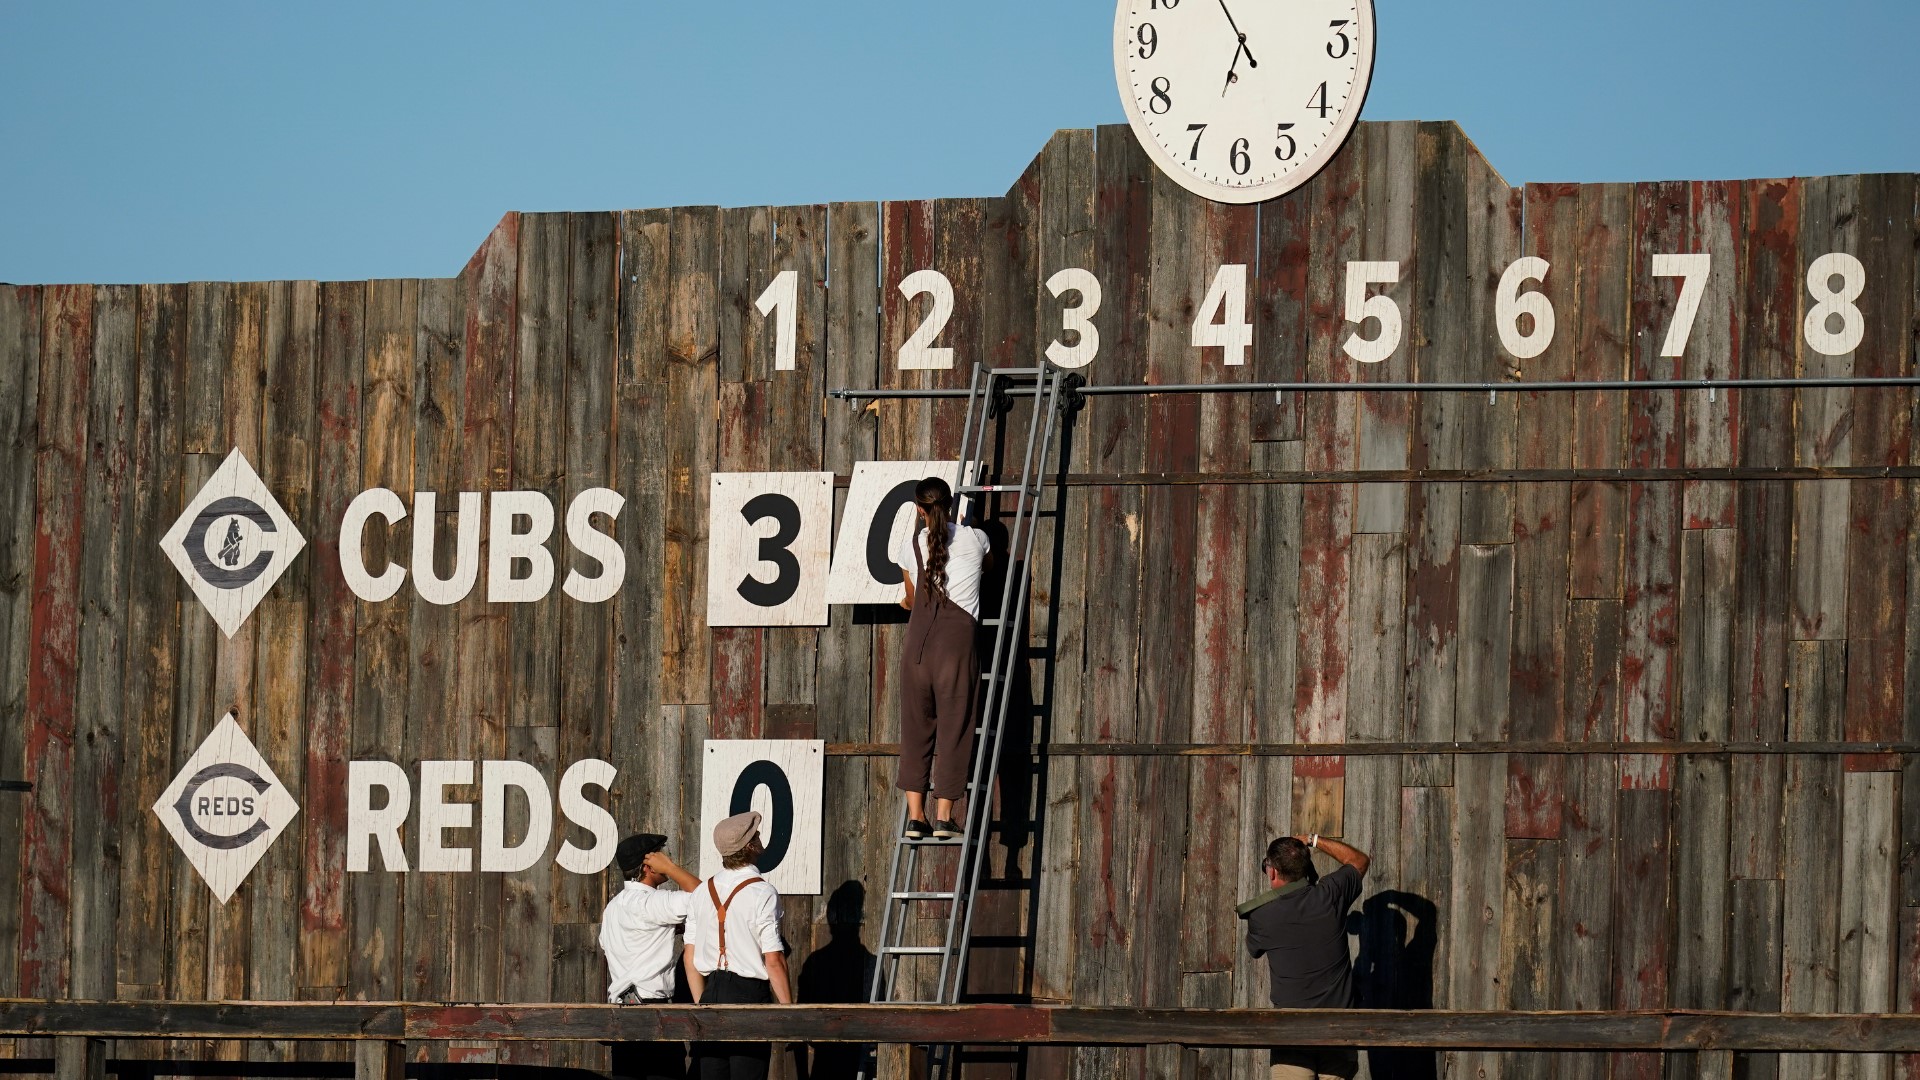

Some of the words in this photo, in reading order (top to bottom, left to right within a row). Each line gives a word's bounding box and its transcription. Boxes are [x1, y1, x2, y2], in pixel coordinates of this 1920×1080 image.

[1136, 22, 1158, 60] 9
[1326, 19, 1350, 59] 3
[1149, 76, 1172, 115] 8
[1305, 80, 1333, 118] 4
[1186, 123, 1208, 160] 7
[1229, 137, 1251, 175] 6
[1274, 122, 1296, 161] 5
[755, 270, 798, 371] 1
[897, 269, 955, 370] 2
[1044, 267, 1101, 370] 3
[1191, 264, 1253, 366] 4
[1342, 261, 1402, 363] 5
[1495, 256, 1556, 358] 6
[1651, 253, 1711, 357] 7
[1803, 252, 1866, 356] 8
[182, 496, 278, 589] C
[339, 487, 627, 605] CUBS
[736, 492, 801, 607] 3
[172, 763, 272, 850] C
[198, 796, 255, 816] REDS
[346, 758, 619, 875] REDS
[729, 759, 794, 874] 0
